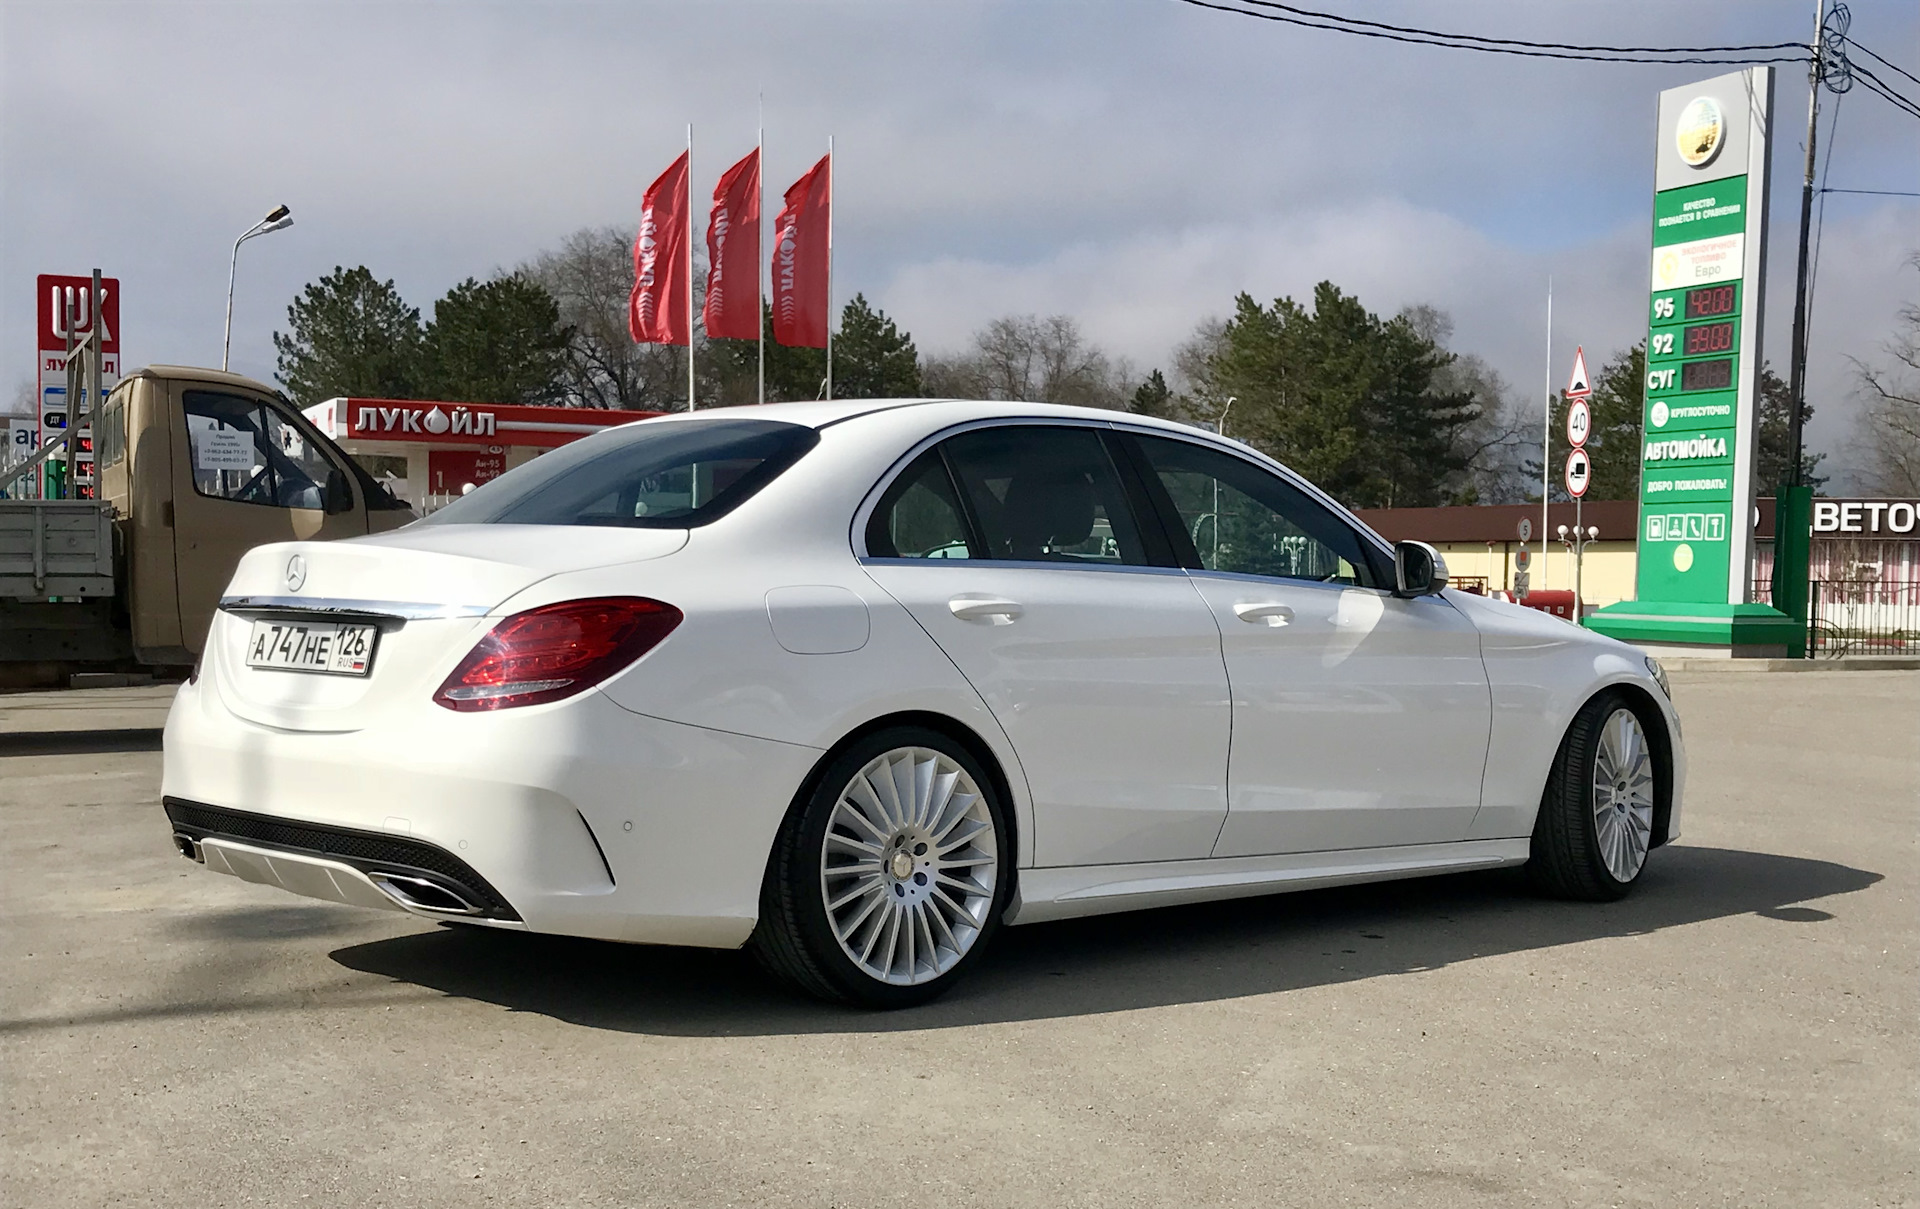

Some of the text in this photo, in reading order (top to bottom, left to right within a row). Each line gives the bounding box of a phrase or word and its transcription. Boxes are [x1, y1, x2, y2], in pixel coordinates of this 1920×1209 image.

[1683, 197, 1716, 212] КАЧЕСТВО
[1658, 204, 1741, 228] ПОЗНАЕТСЯ В СРАВНЕНИИ
[1691, 252, 1726, 264] ТОПЛИВО
[1695, 265, 1721, 279] Евро
[1654, 298, 1674, 319] 95
[1652, 324, 1732, 354] 92 39.00
[1648, 369, 1675, 390] СУГ
[50, 415, 60, 425] ДТ
[355, 405, 496, 437] ЛУКОЙЛ
[1671, 405, 1731, 418] КРУГЛОСУТОЧНО
[1572, 412, 1586, 432] 40
[1645, 434, 1727, 461] АВТОМОЙКА
[436, 470, 443, 488] 1
[1647, 479, 1727, 493] ДОБРО ПОЖАЛОВАТЬ!
[1809, 502, 1920, 537] ВЕТО
[1522, 525, 1529, 536] 5
[337, 626, 366, 655] 126
[337, 657, 353, 668] RUS
